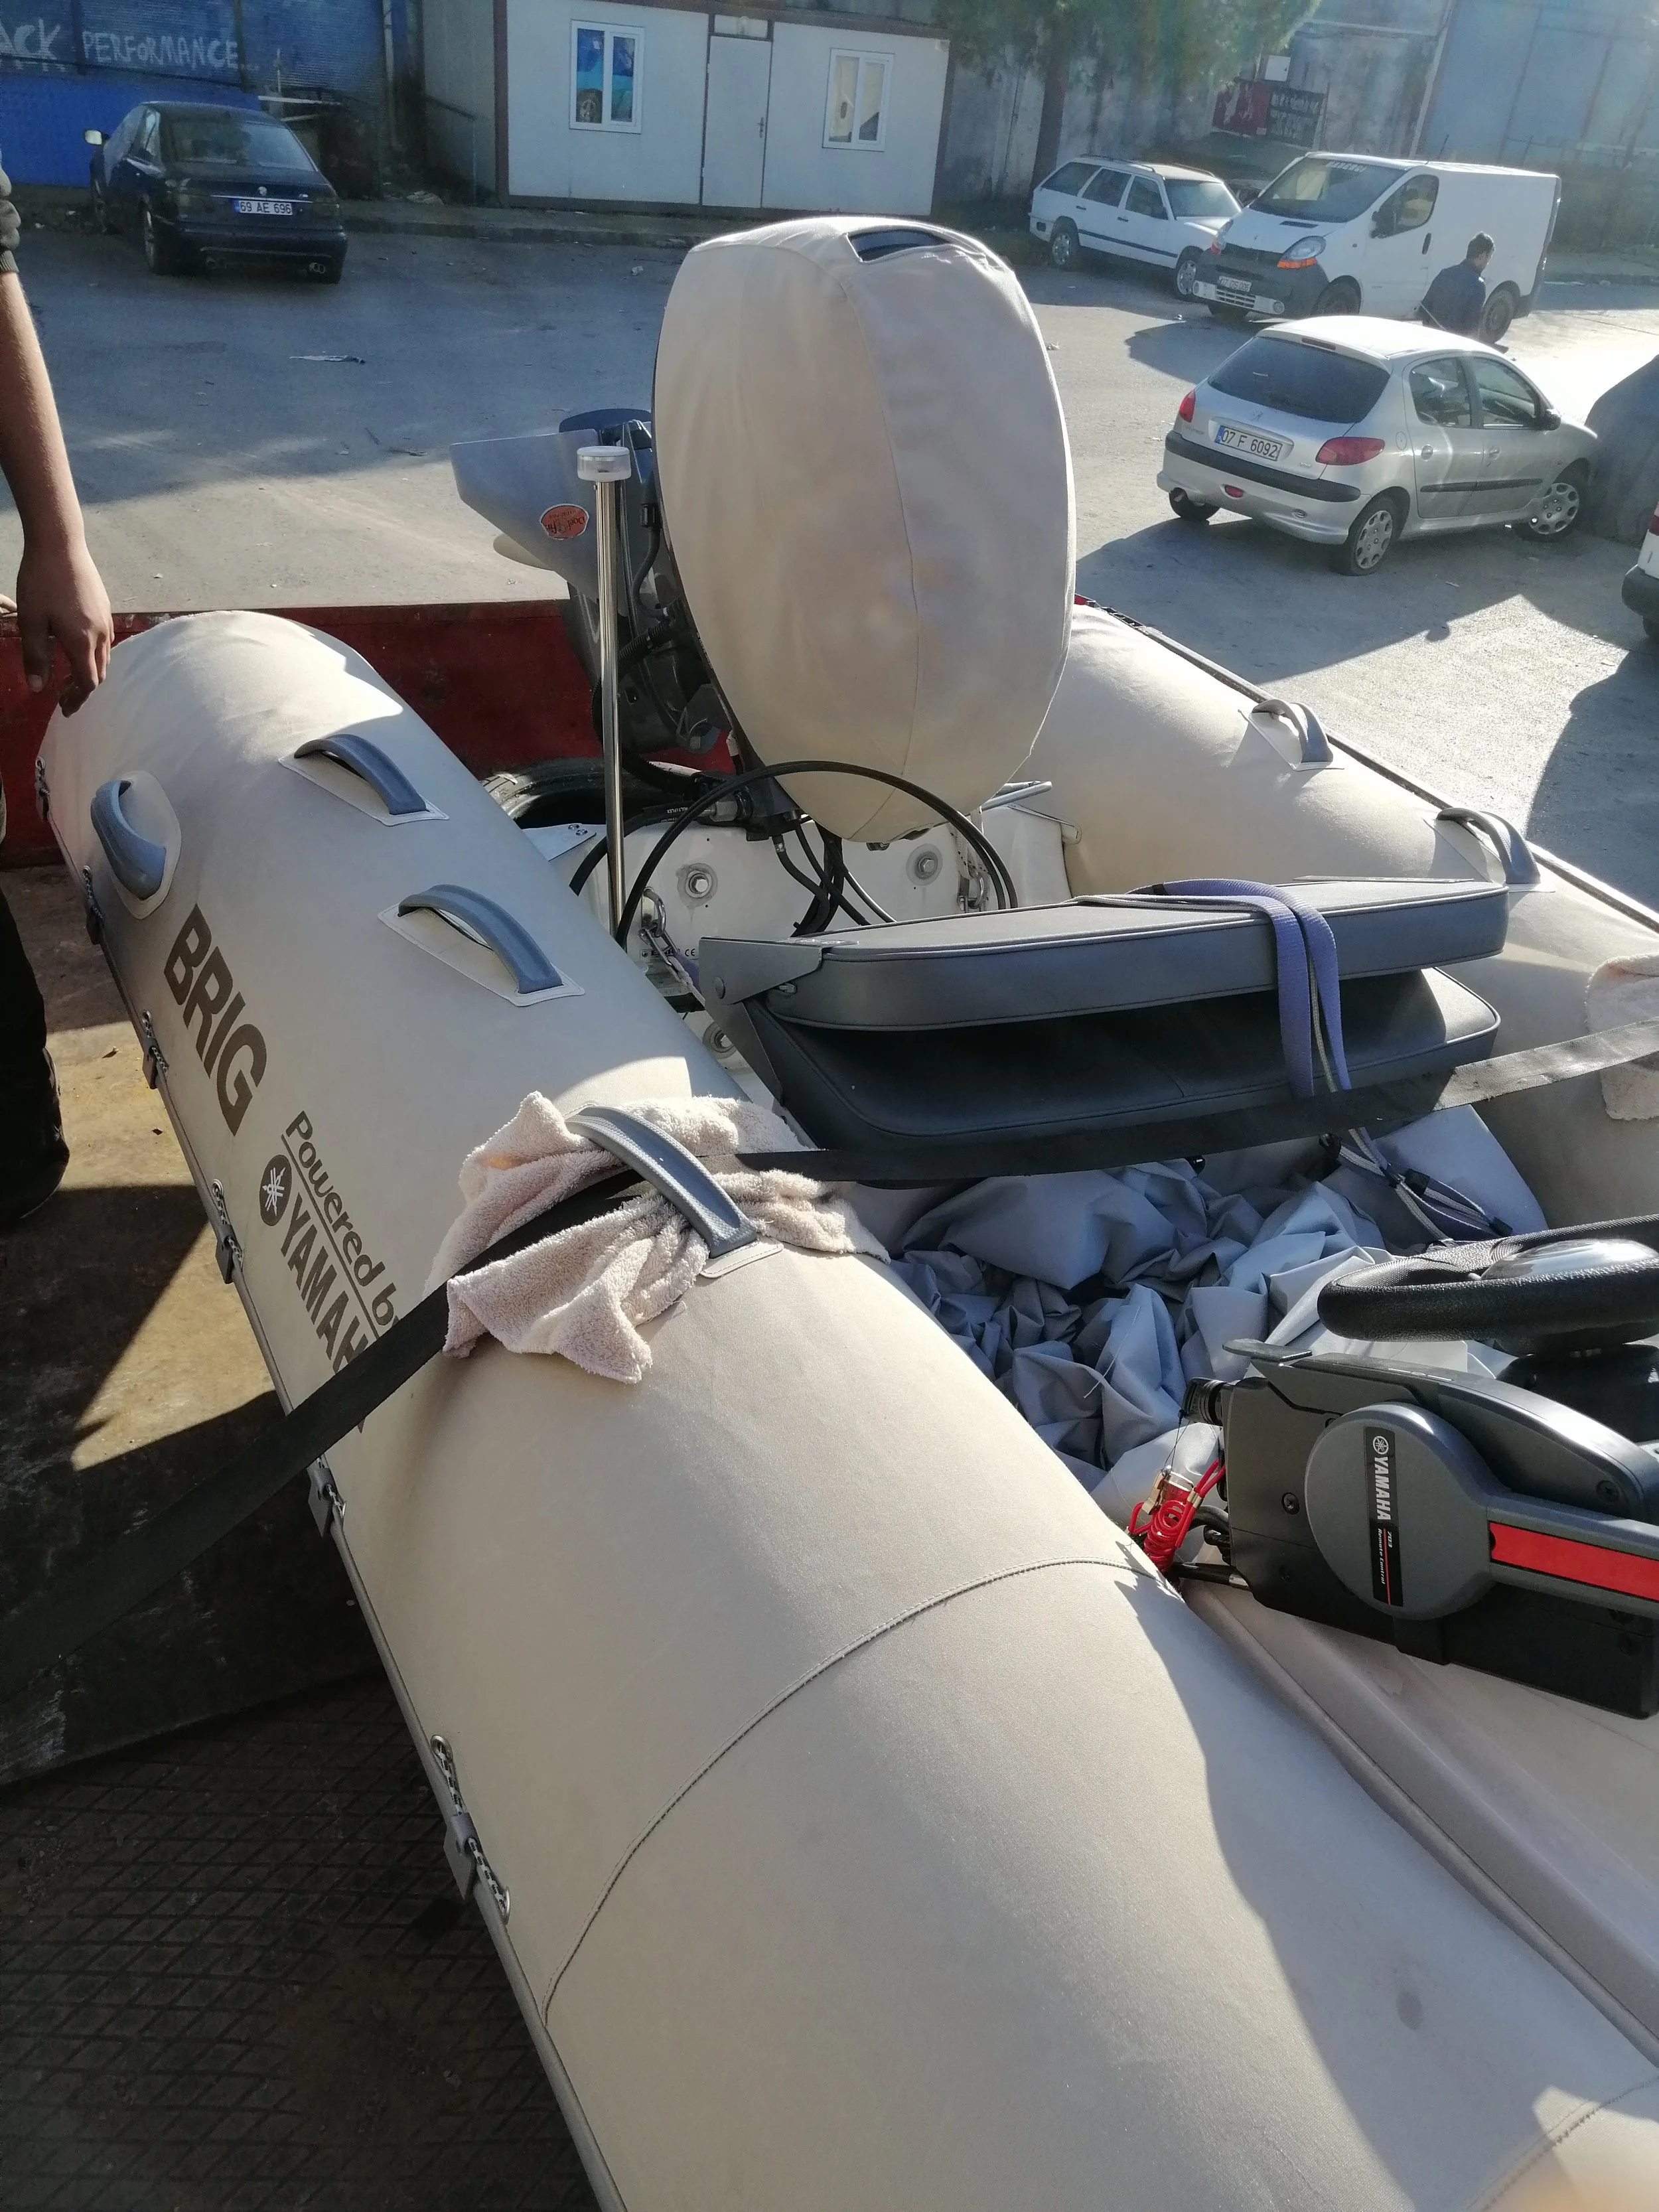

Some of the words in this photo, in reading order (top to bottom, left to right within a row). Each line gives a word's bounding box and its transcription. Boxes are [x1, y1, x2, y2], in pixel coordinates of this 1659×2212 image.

[240, 201, 252, 212] 69
[257, 202, 269, 213] AE
[273, 203, 291, 214] 696
[1222, 429, 1236, 443] 07
[1237, 434, 1248, 447] F
[1250, 438, 1279, 459] 6092
[163, 903, 267, 1136] BRIG
[286, 1110, 385, 1288] Powered
[372, 1281, 401, 1327] b
[280, 1196, 369, 1434] YAMAH
[1374, 1456, 1392, 1520] YAMAHA
